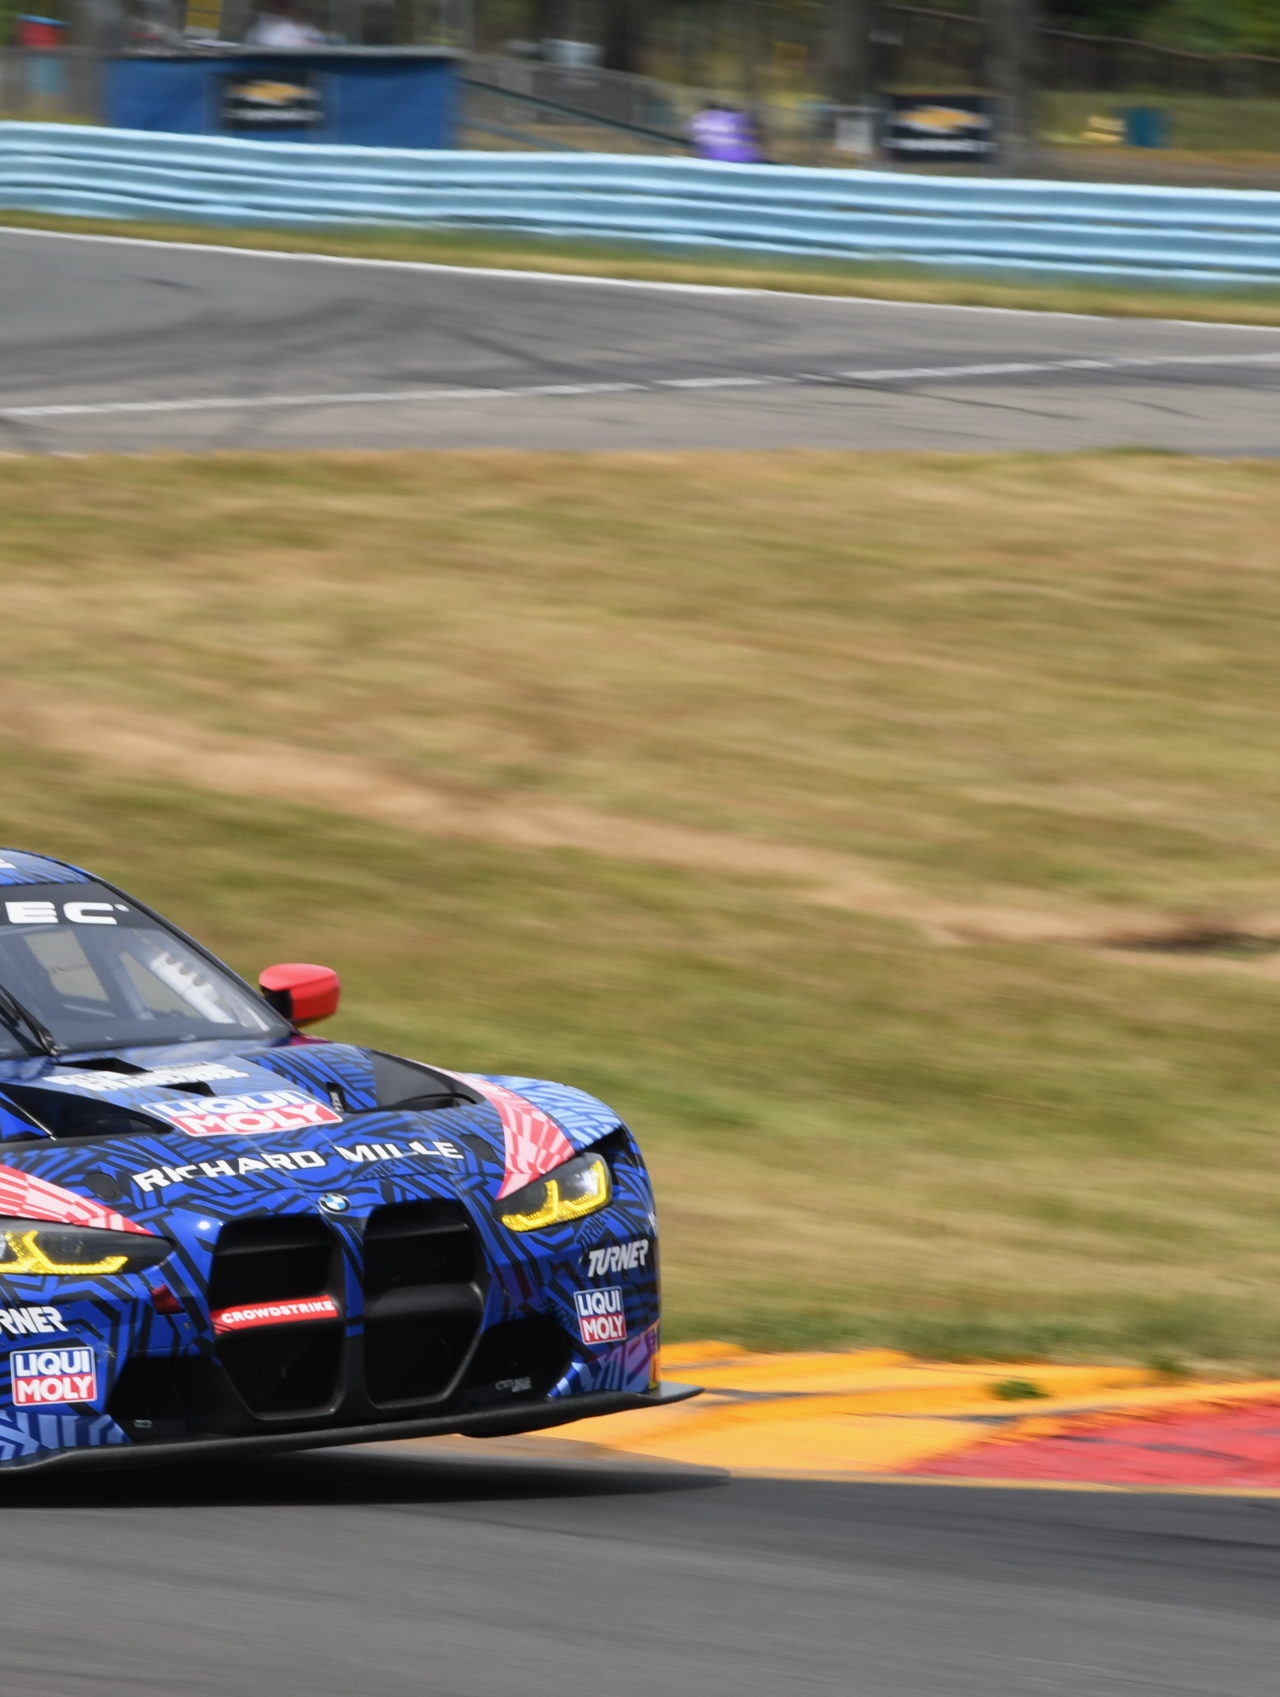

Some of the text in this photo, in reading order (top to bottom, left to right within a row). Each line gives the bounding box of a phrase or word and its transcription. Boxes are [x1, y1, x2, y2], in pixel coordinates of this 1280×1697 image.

[154, 1090, 310, 1117] LIQUI
[178, 1103, 326, 1135] MOLY
[131, 1140, 465, 1193] RICHARD MILLE
[587, 1238, 649, 1278] TURNER
[221, 1300, 336, 1324] CROWDSTRIKE
[577, 1289, 622, 1317] LIQUI
[581, 1314, 625, 1343] MOLY
[15, 1349, 91, 1378] LIQUI
[17, 1375, 94, 1403] MOLY
